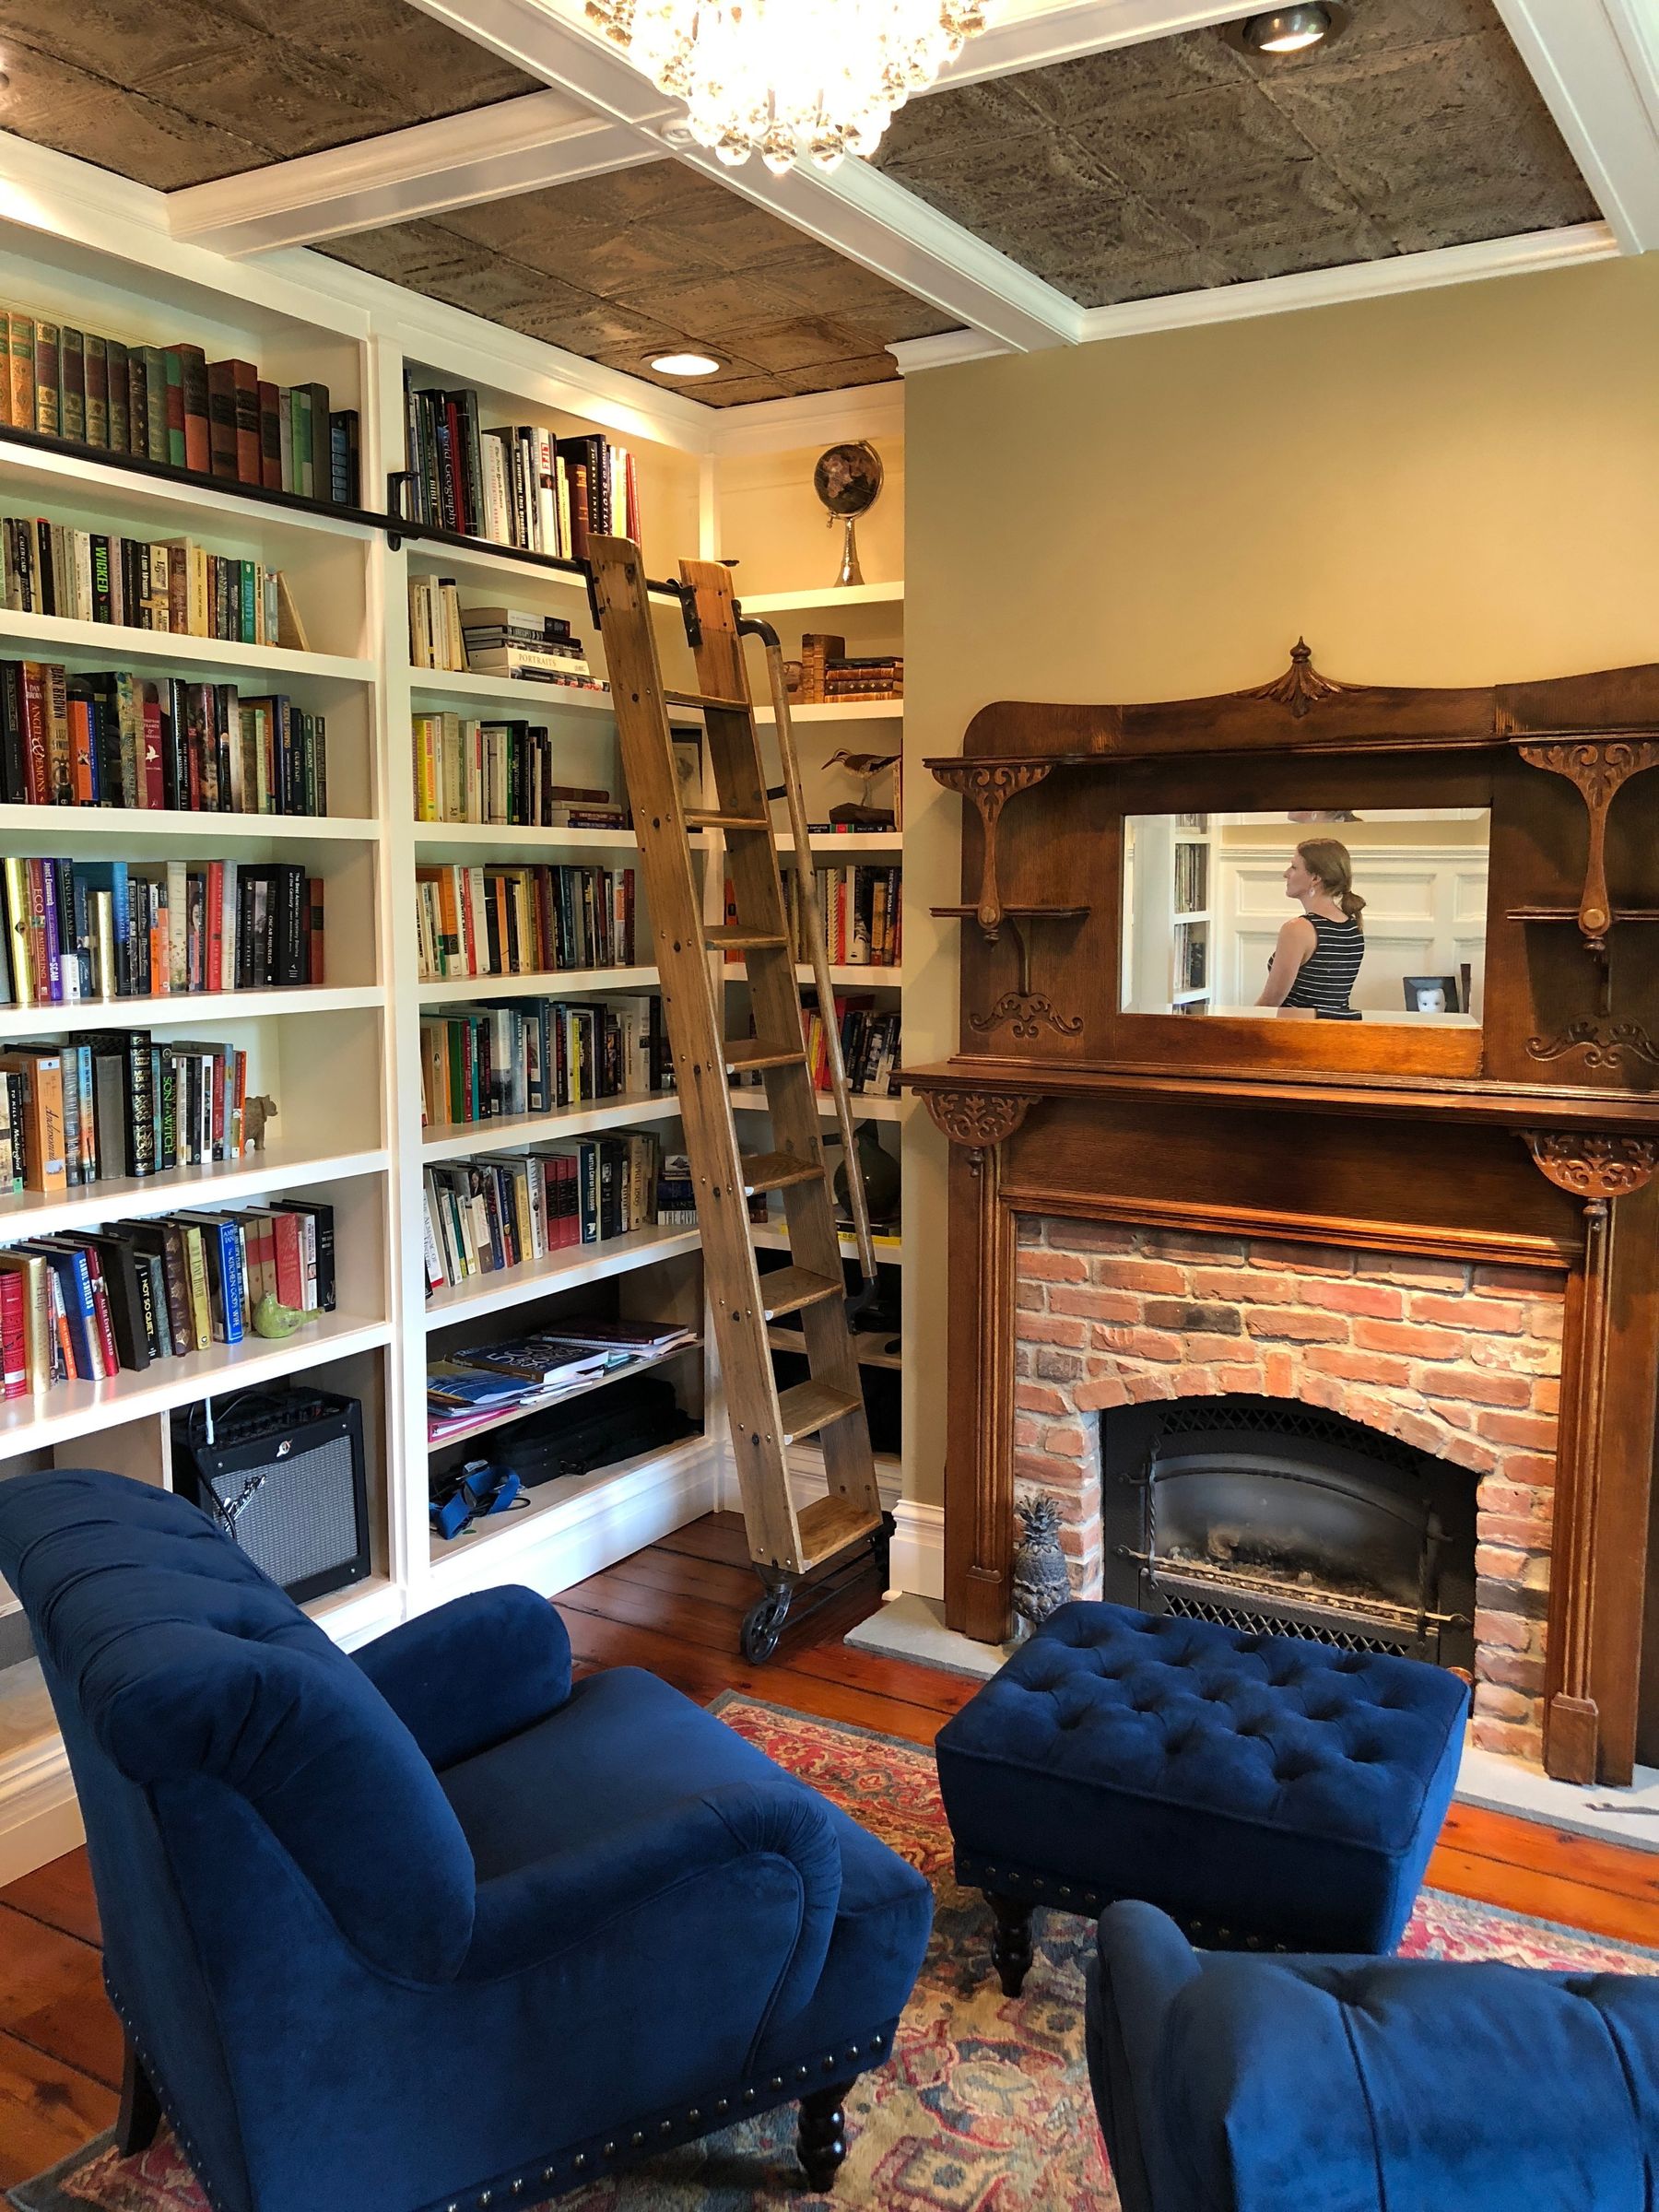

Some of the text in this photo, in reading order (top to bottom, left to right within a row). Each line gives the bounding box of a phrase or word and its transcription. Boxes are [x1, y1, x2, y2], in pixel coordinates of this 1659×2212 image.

[541, 442, 550, 469] LIFE
[442, 424, 457, 528] World Geography
[429, 480, 438, 508] BIBLE
[95, 547, 109, 593] WICKED
[244, 581, 253, 620] TRINITY
[518, 653, 557, 666] PORTRAITS
[51, 667, 66, 719] DAN BROWN
[31, 737, 45, 758] &
[34, 753, 45, 793] DEMONS
[125, 731, 135, 795] JIMMY CARTER
[34, 888, 43, 913] ECO
[45, 878, 54, 906] Evanovich
[50, 962, 59, 982] SCAM
[38, 931, 47, 979] BAUDOLINO
[11, 1089, 16, 1098] TO
[162, 1077, 172, 1101] SON
[66, 1120, 76, 1136] Larry
[164, 1115, 173, 1155] WITCH
[12, 1128, 21, 1171] Mockingbird
[67, 1137, 78, 1166] McMurtry
[664, 1211, 697, 1225] THE CIVI
[223, 1229, 234, 1238] AMY
[78, 1258, 94, 1310] CAROL SHIELDS
[228, 1256, 236, 1287] KITCHEN
[35, 1287, 46, 1312] Help
[142, 1278, 153, 1297] NOT
[143, 1298, 151, 1311] SO
[102, 1310, 108, 1318] HE
[105, 1332, 114, 1356] WANTED
[486, 1344, 554, 1364] 500
